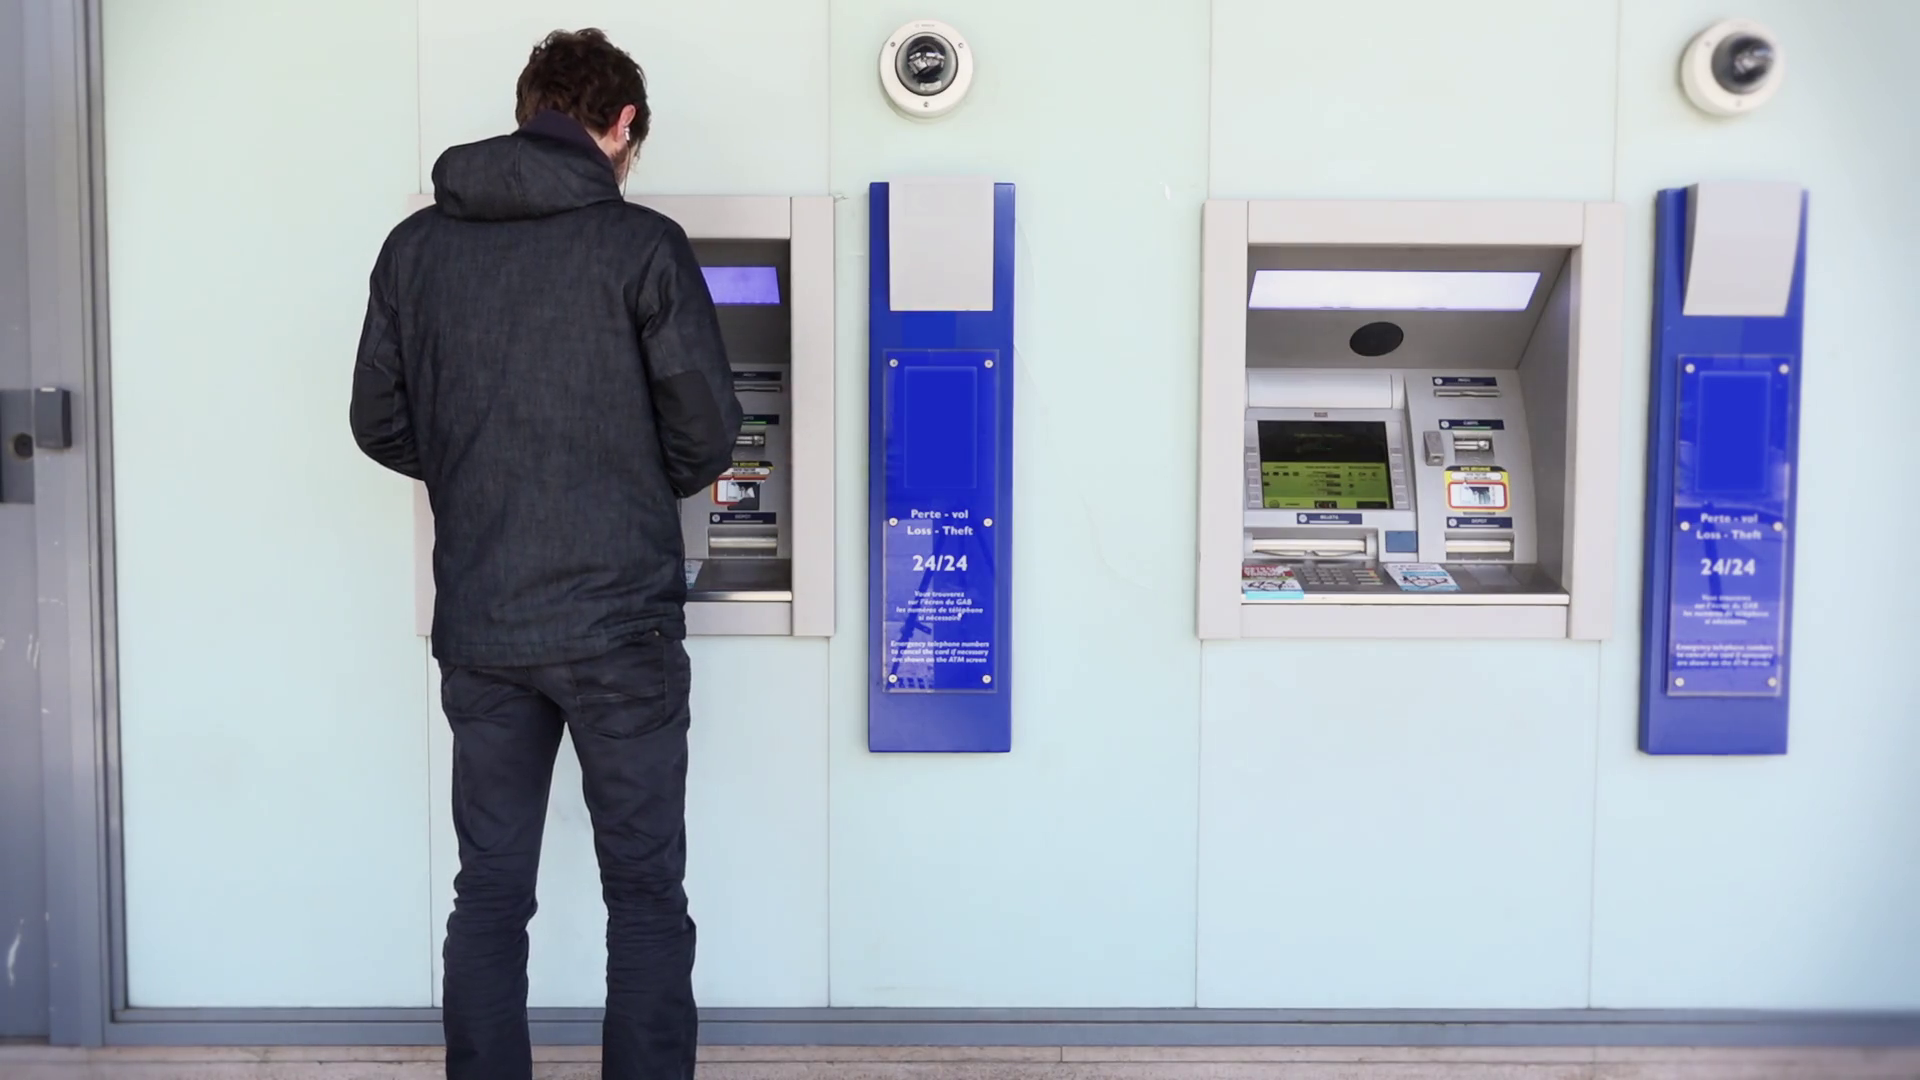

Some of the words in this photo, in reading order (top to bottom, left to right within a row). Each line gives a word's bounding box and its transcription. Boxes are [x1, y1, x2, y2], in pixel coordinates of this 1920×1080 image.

[911, 509, 941, 519] Perte
[952, 509, 968, 518] vol
[1701, 513, 1731, 523] Perte
[1741, 514, 1758, 523] vol
[907, 526, 932, 535] Loss
[942, 526, 973, 535] Theft
[1696, 530, 1721, 540] Loss
[1731, 530, 1762, 540] Theft
[912, 555, 968, 571] 24/24
[1700, 558, 1755, 576] 24/24
